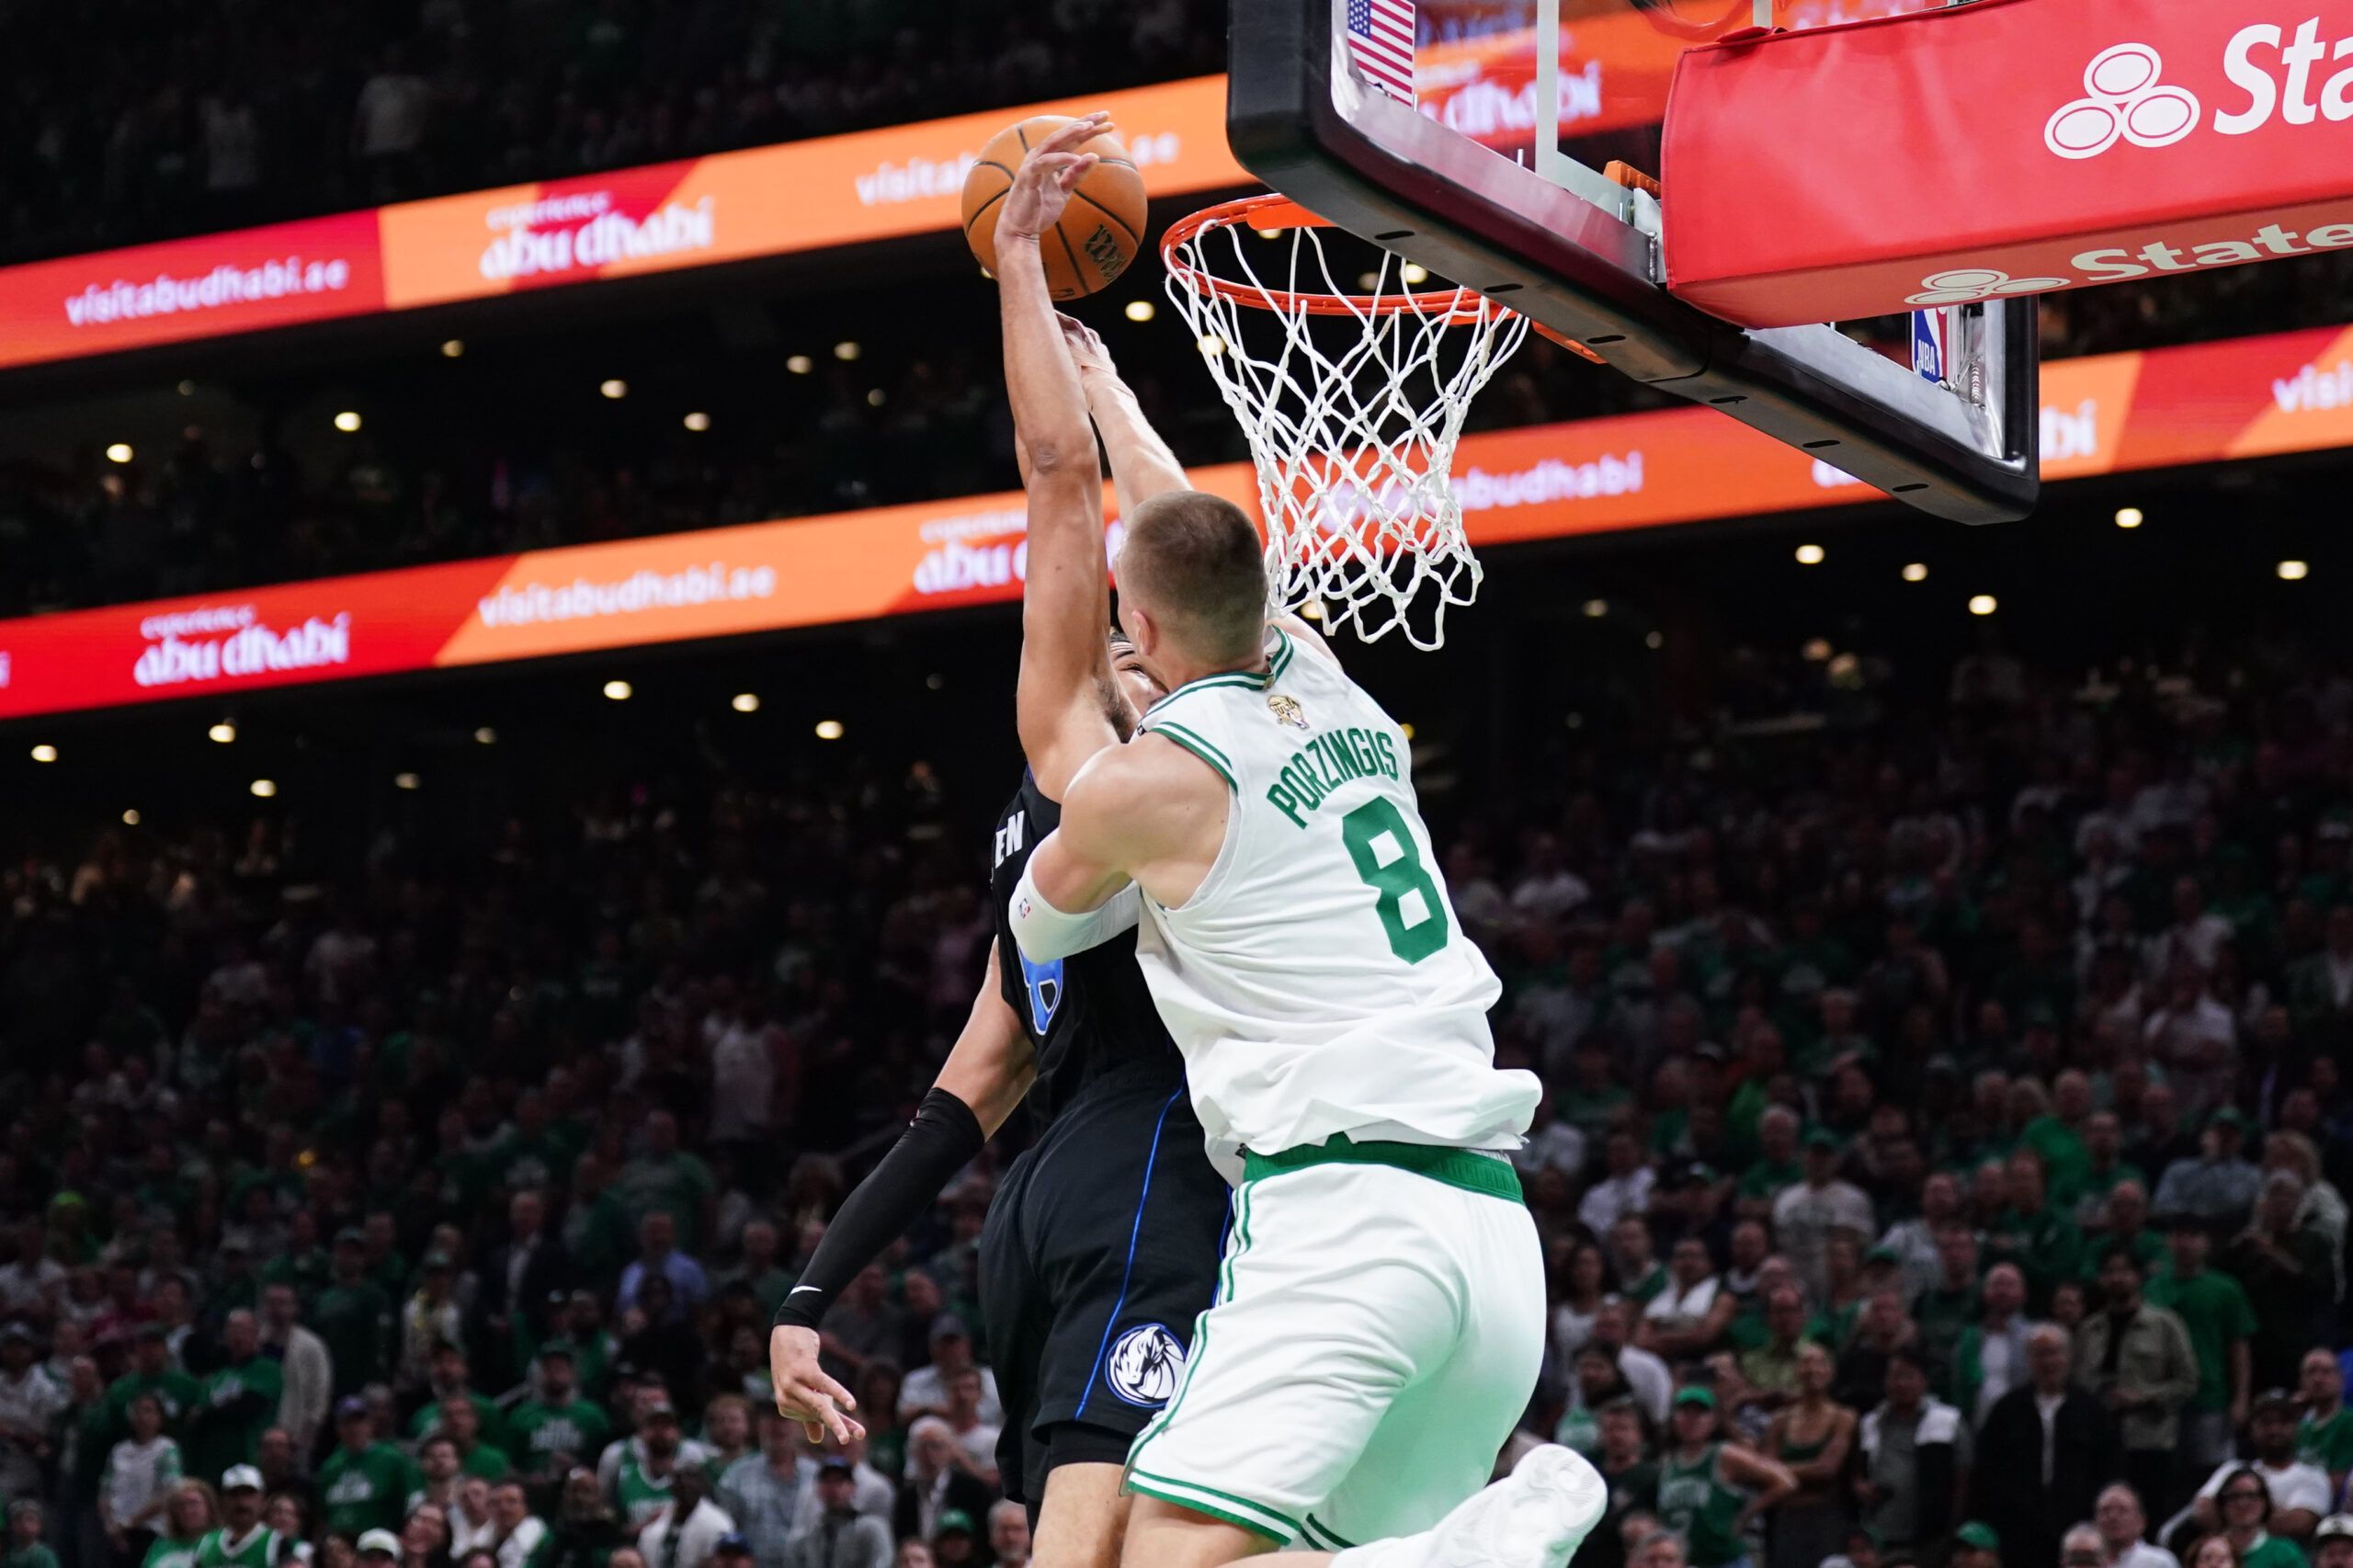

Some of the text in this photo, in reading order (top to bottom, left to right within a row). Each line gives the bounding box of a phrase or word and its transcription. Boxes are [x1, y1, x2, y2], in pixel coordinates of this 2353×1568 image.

[2071, 223, 2353, 281] State
[64, 256, 349, 327] visitabudhabi.ae
[1916, 338, 1936, 376] NBA
[478, 560, 778, 628] visitabudhabi.ae
[1266, 727, 1399, 830] PORZINGIS
[1342, 795, 1449, 965] 8
